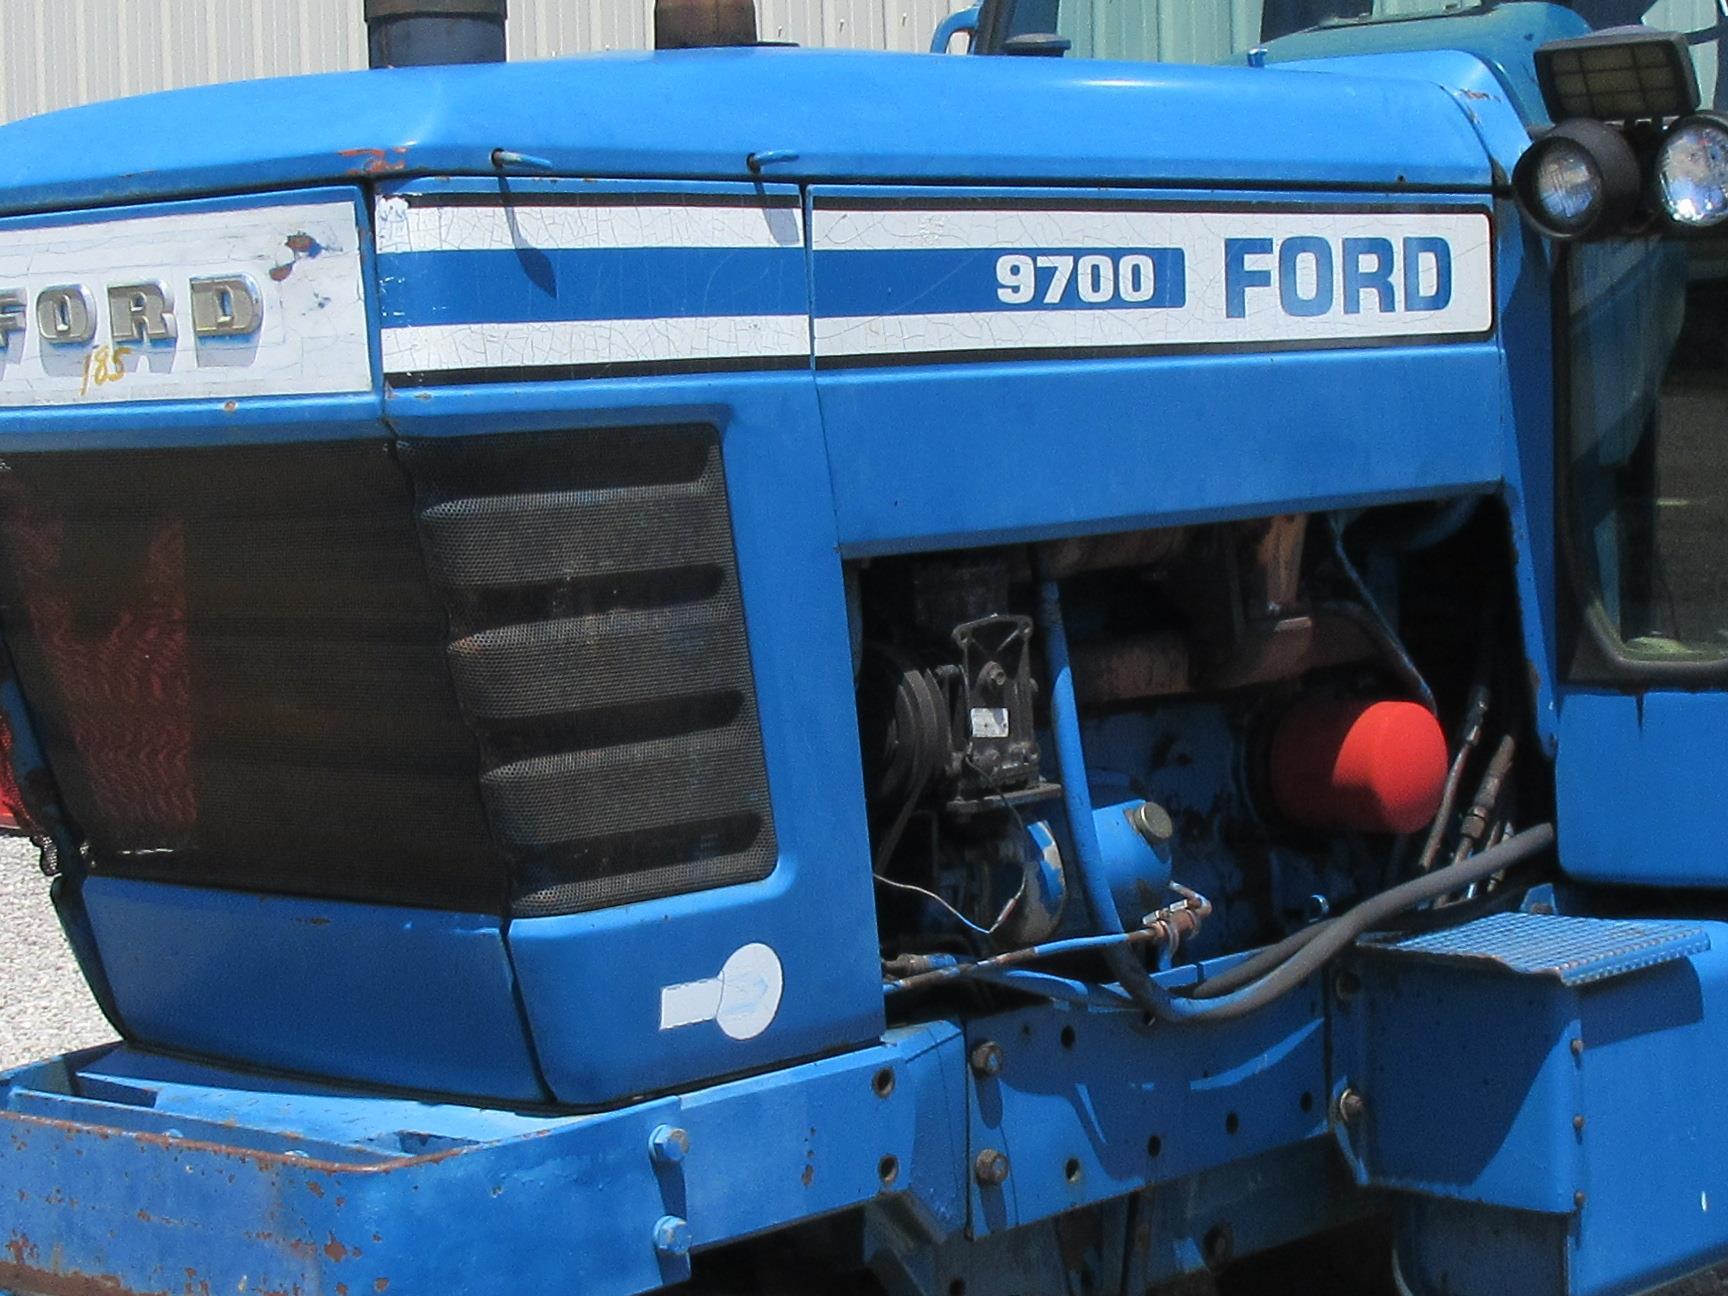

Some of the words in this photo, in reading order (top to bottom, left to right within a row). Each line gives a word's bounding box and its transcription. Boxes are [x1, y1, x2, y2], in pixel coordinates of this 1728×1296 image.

[995, 254, 1156, 304] 9700
[1223, 235, 1453, 319] FORD
[79, 346, 132, 396] 185
